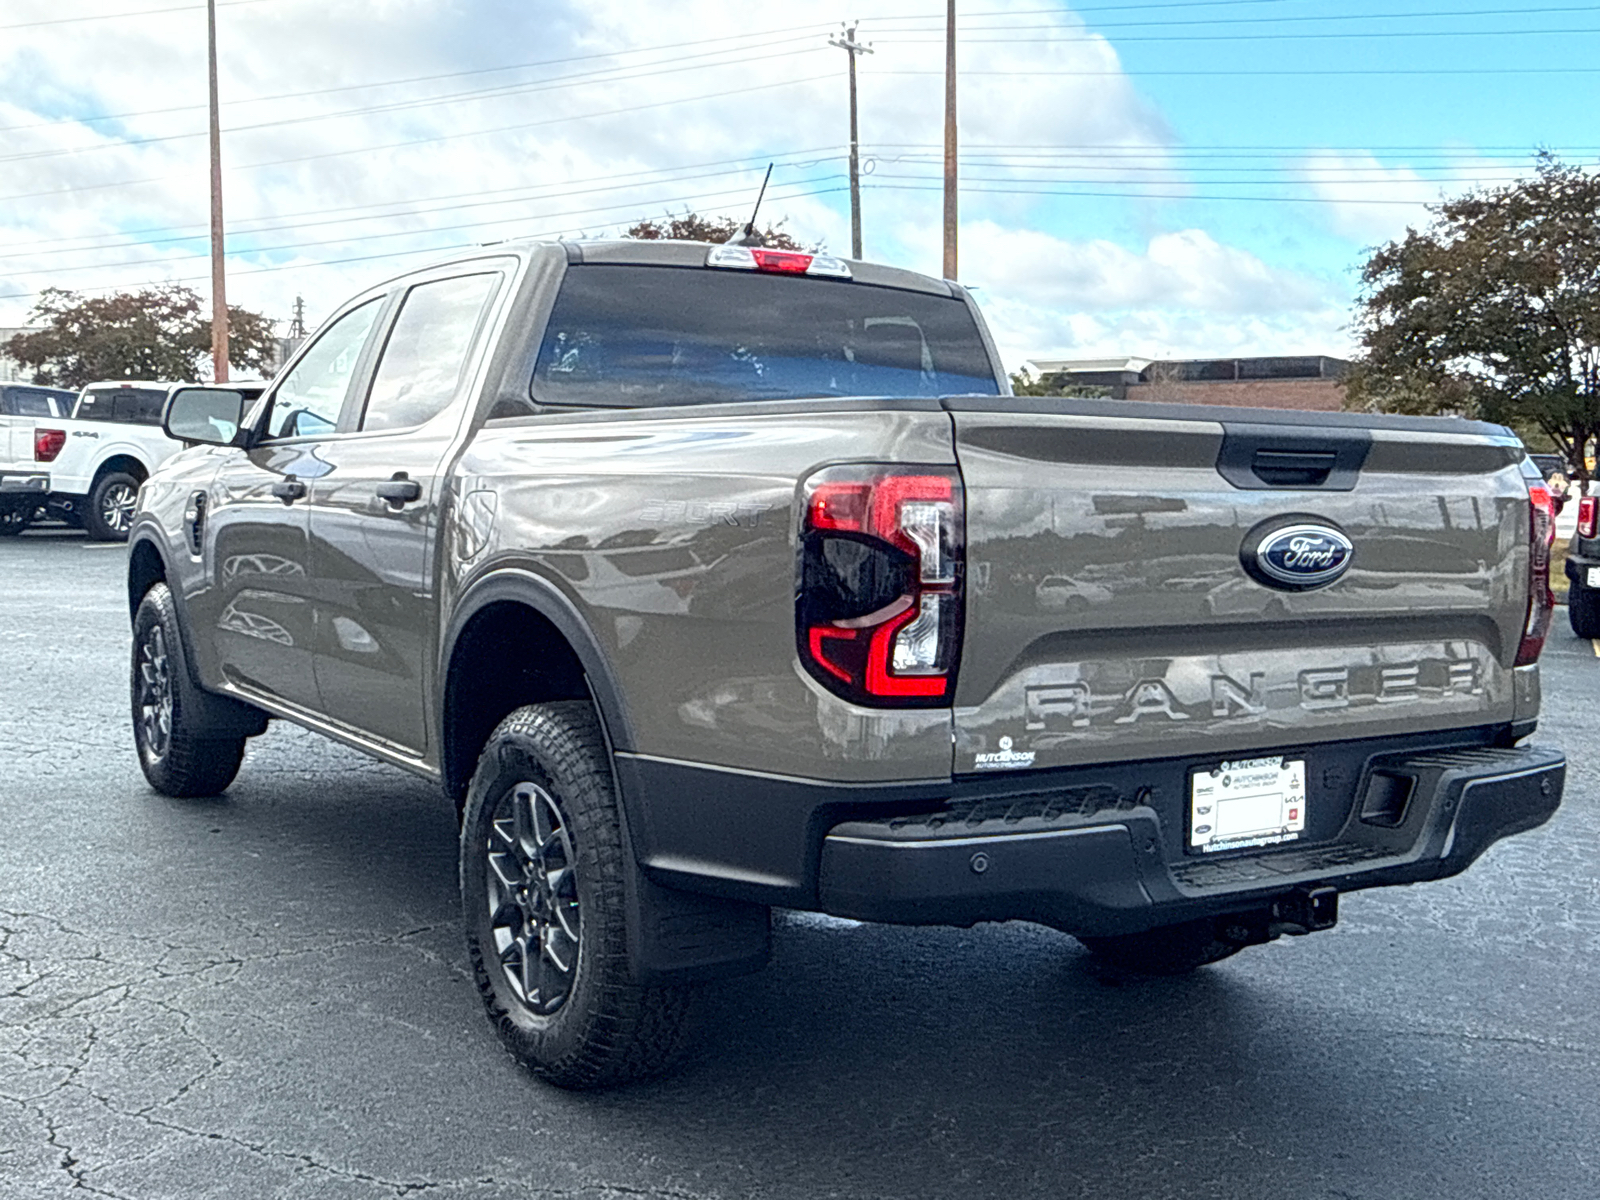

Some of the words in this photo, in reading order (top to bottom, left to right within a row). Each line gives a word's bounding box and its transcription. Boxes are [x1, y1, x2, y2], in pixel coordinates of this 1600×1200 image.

[639, 498, 773, 528] SPORT
[1283, 536, 1336, 568] Ford
[1024, 657, 1483, 730] RANGER
